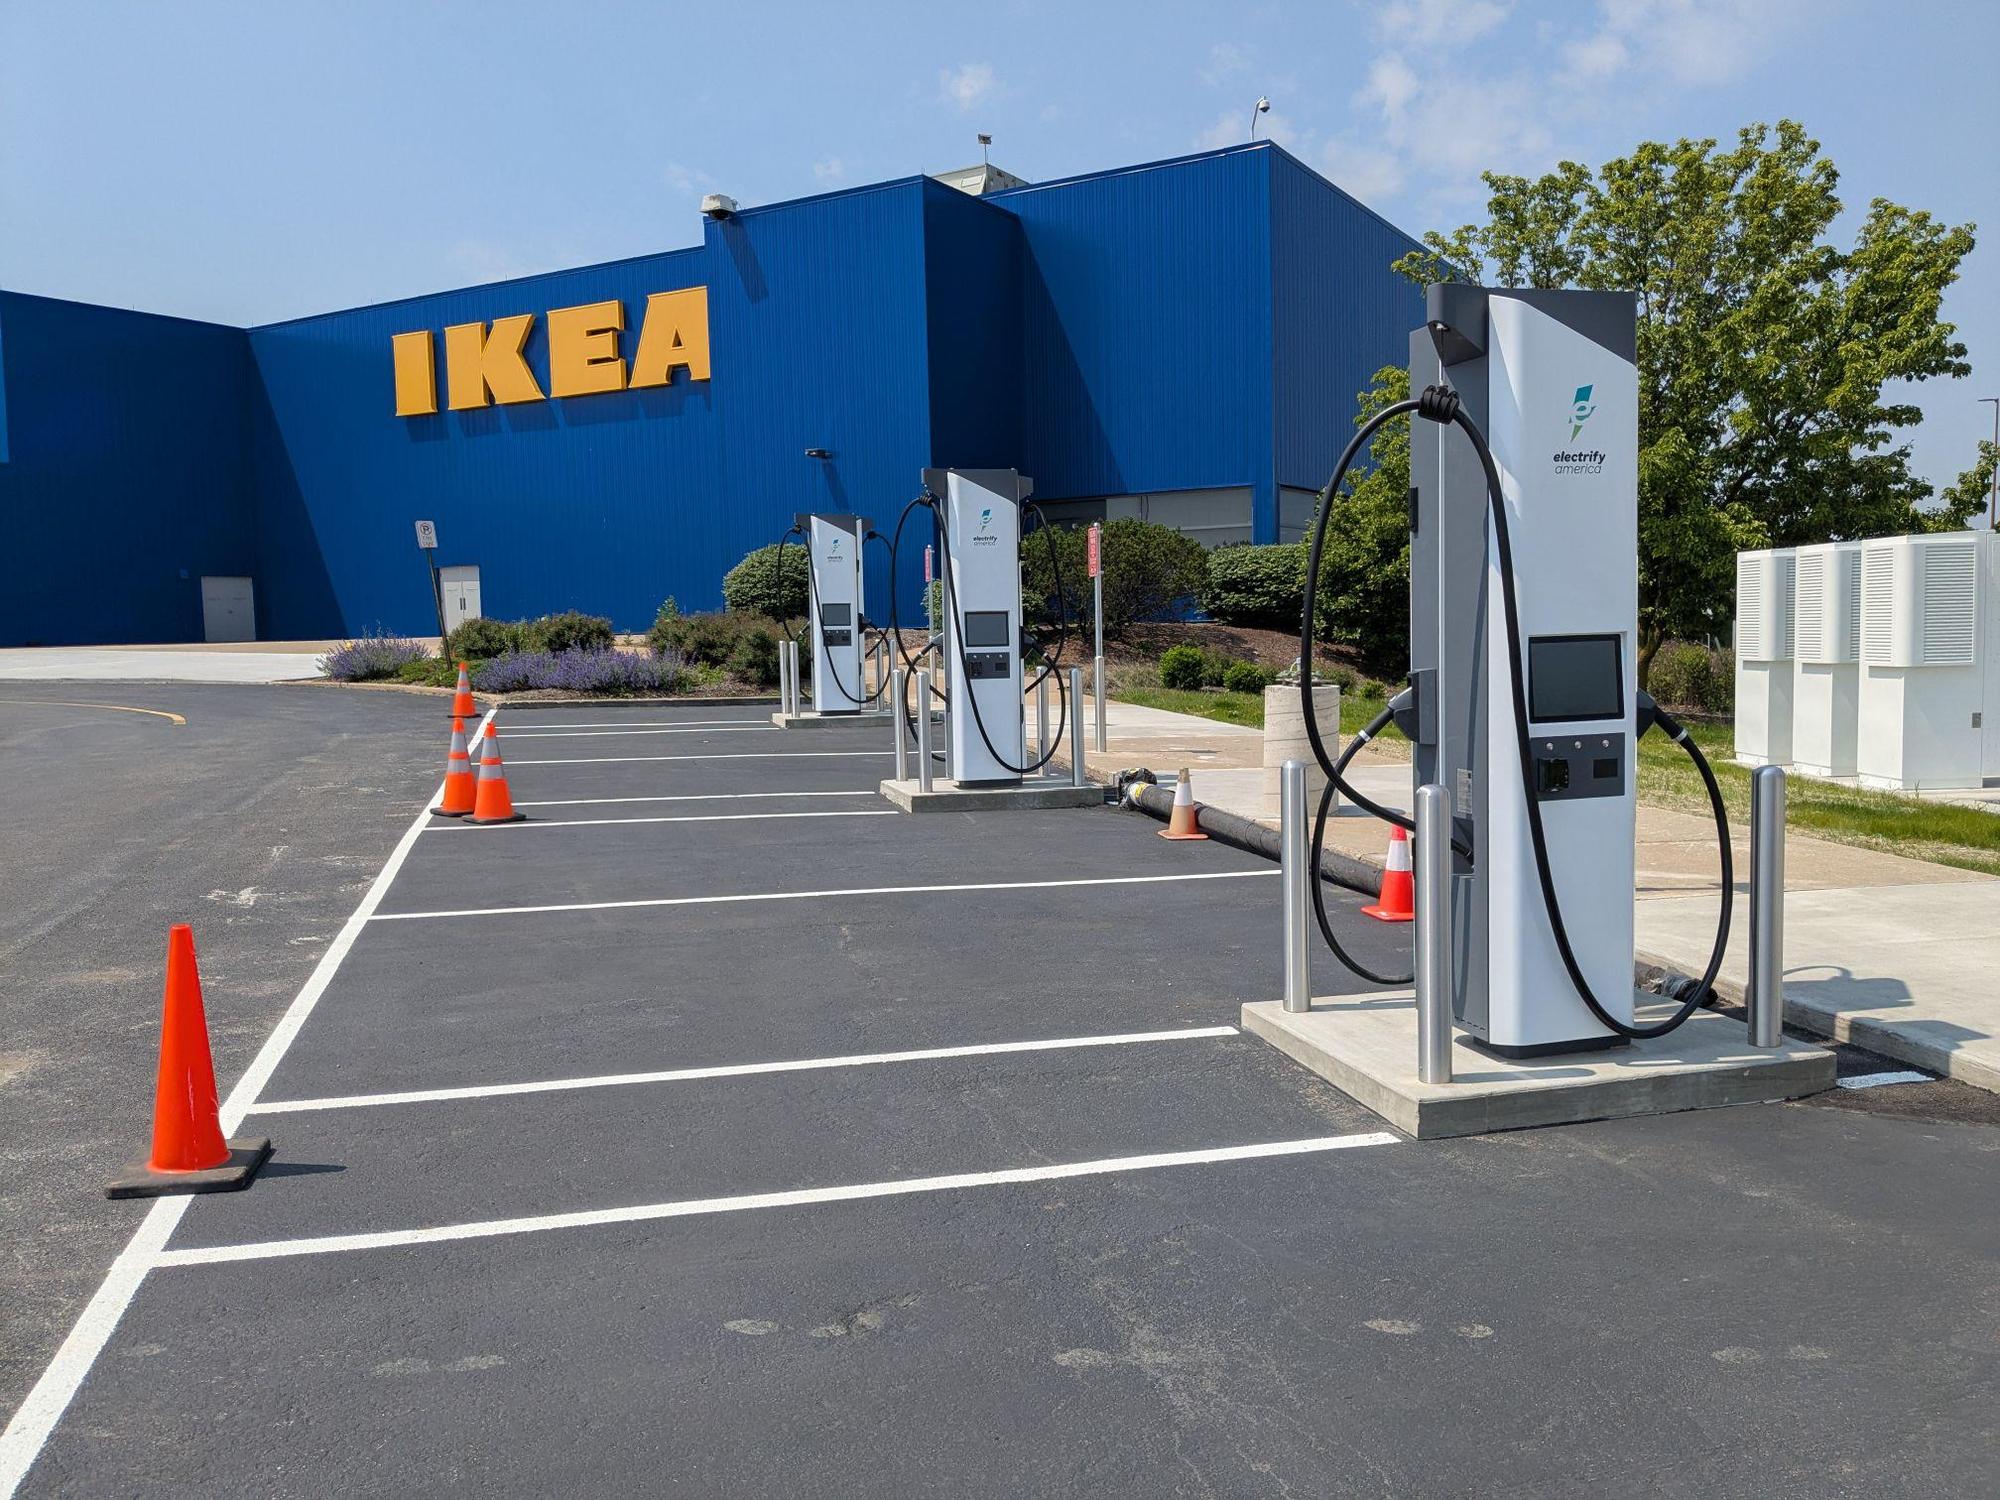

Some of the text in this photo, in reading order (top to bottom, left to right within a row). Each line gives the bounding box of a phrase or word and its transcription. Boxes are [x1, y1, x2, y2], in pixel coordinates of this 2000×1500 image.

[391, 285, 711, 417] IKEA
[1553, 450, 1606, 464] electrify
[1554, 464, 1602, 475] america
